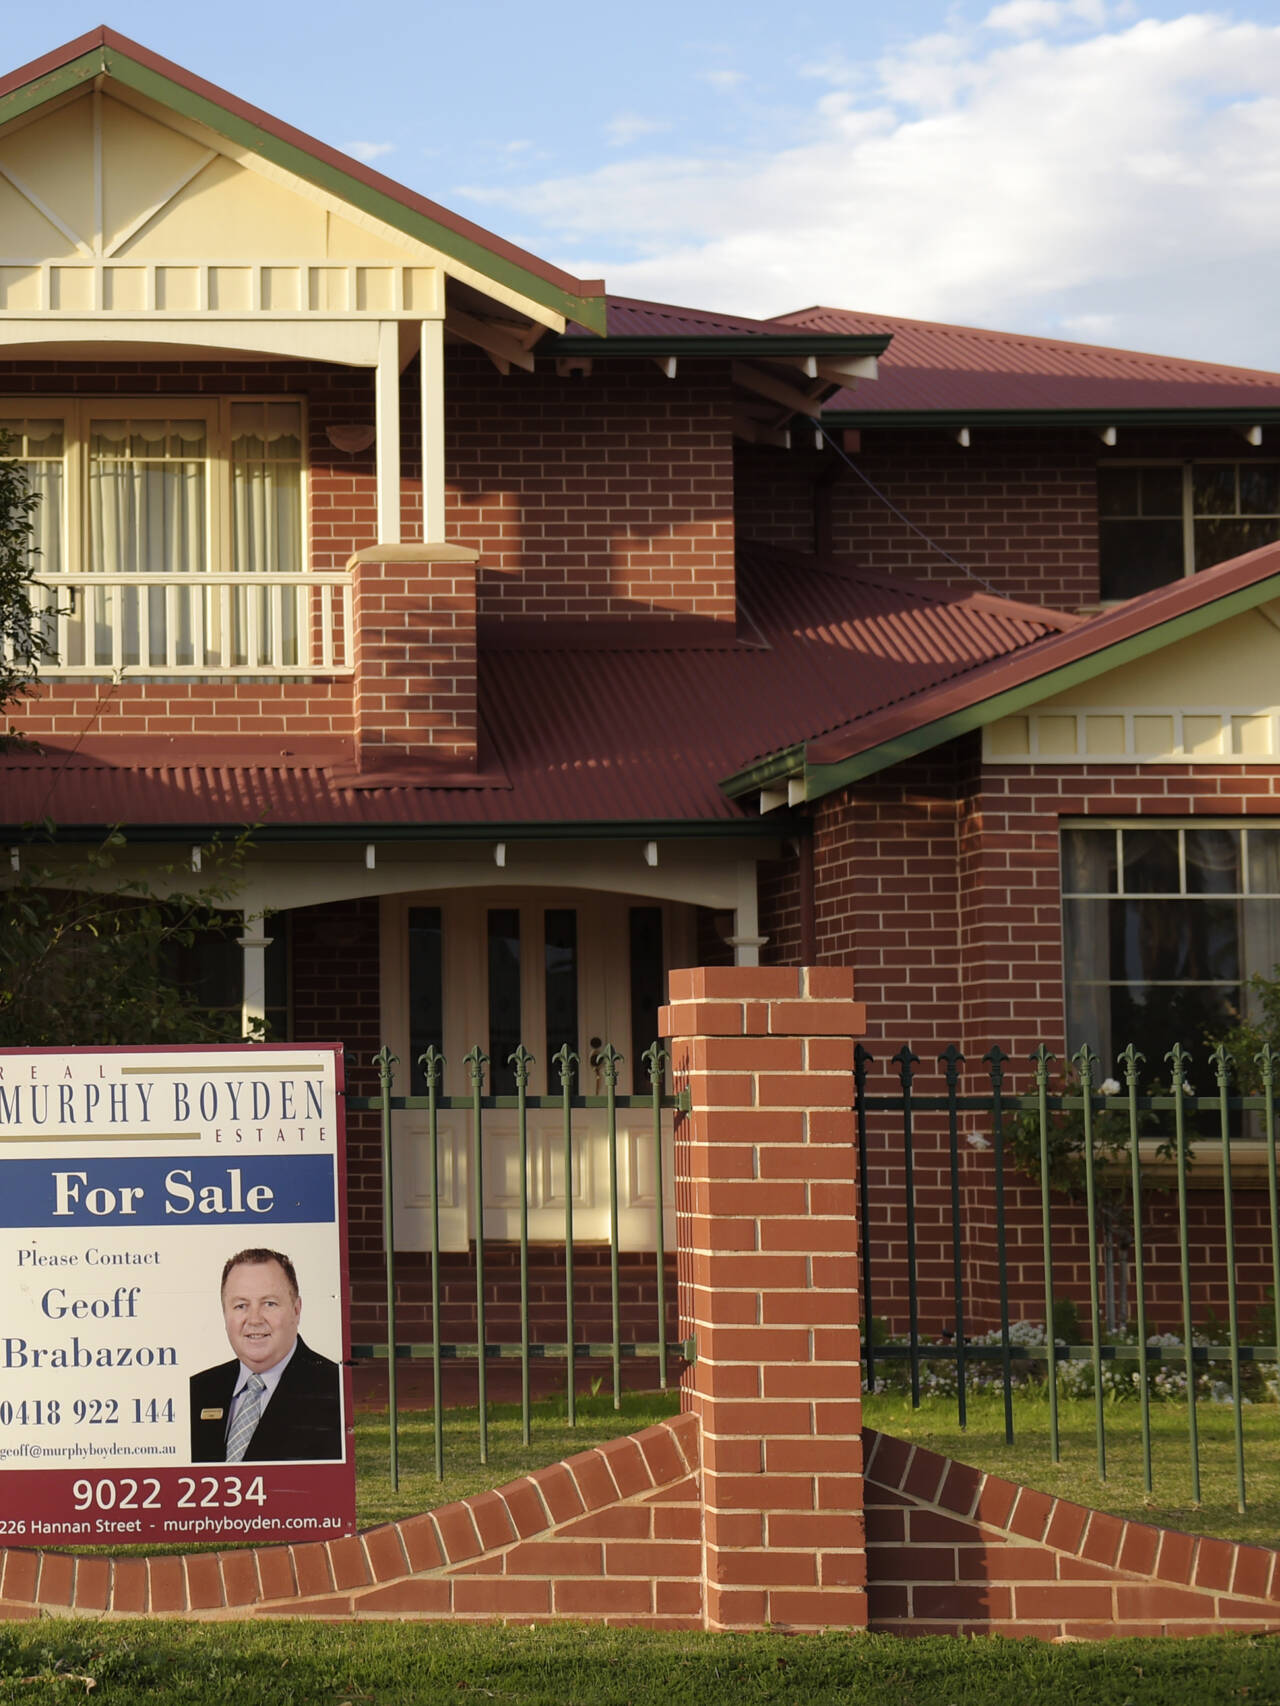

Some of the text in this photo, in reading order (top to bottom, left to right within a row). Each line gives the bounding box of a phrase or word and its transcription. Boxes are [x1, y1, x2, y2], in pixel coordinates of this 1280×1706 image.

[174, 1080, 325, 1121] BOYDEN
[215, 1128, 326, 1142] ESTATE
[51, 1168, 274, 1216] For Sale
[17, 1248, 160, 1267] Please Contact
[41, 1287, 141, 1319] Geoff
[2, 1337, 179, 1368] Brabazon
[0, 1397, 175, 1426] 0418 922 144
[0, 1443, 176, 1460] geoff@murphyboyden.com.au
[72, 1476, 267, 1511] 9022 2234
[30, 1519, 91, 1535] Hannan
[96, 1517, 142, 1533] Street
[163, 1515, 341, 1534] murphyboyden.com.au
